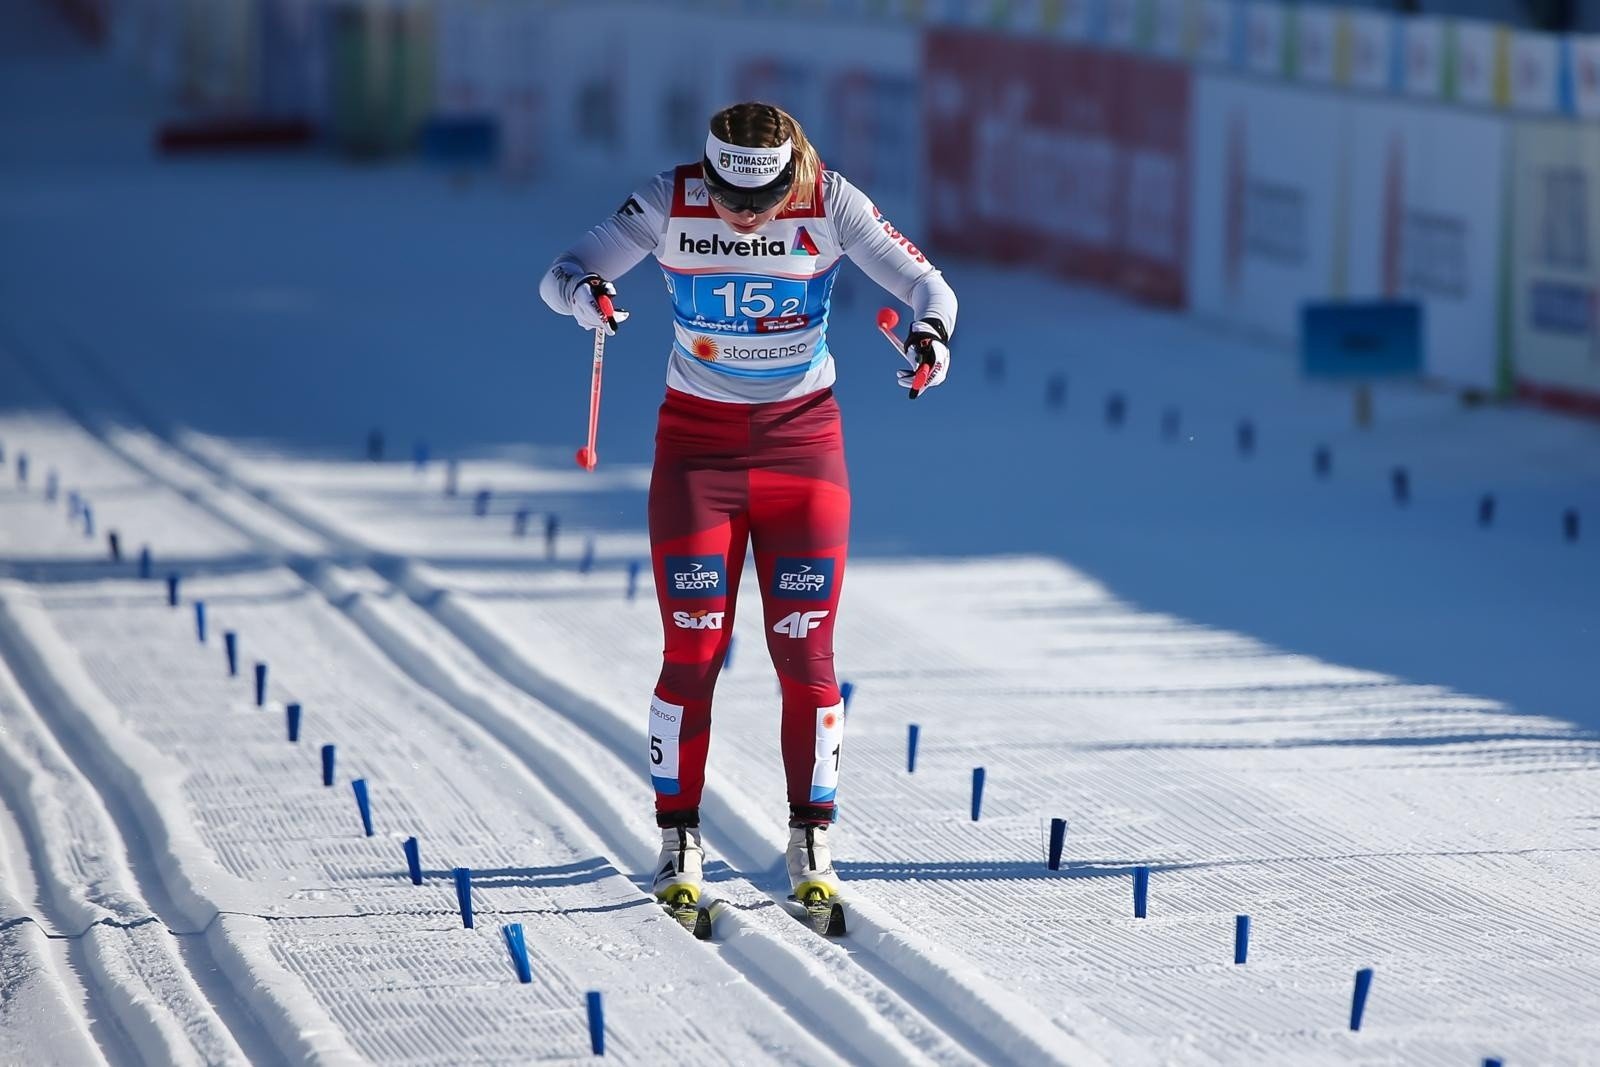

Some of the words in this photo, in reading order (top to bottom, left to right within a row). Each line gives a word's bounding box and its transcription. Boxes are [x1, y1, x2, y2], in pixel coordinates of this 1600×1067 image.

[732, 165, 777, 175] LUBELSKI
[679, 232, 786, 257] helvetia
[713, 282, 775, 318] 15
[780, 298, 800, 318] 2
[723, 342, 808, 360] storaenso
[672, 610, 725, 630] SIXT
[772, 610, 830, 639] 4F
